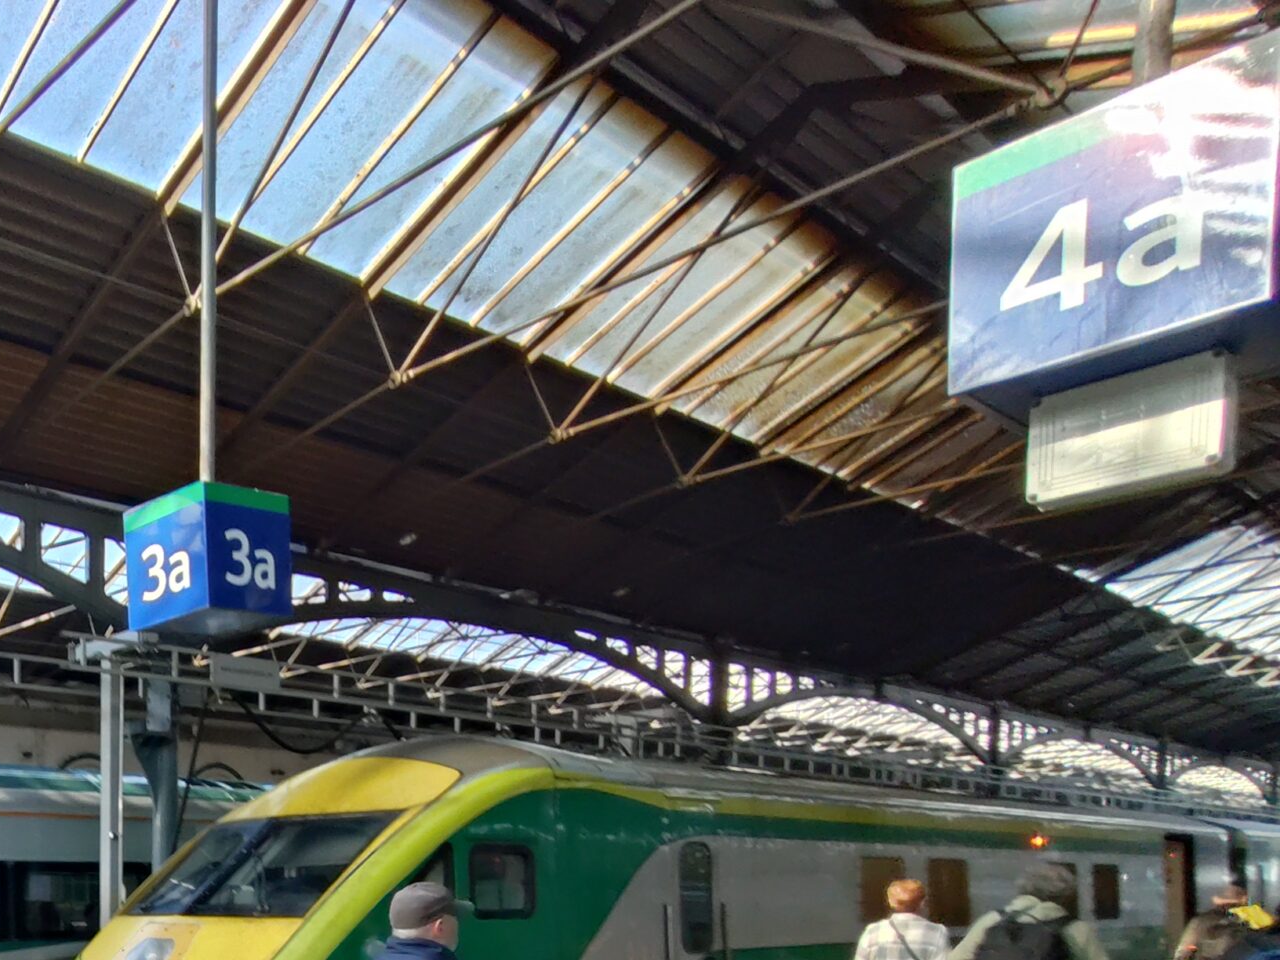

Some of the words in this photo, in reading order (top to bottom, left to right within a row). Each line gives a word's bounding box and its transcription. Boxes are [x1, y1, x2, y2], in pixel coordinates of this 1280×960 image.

[999, 196, 1204, 312] 4a
[141, 543, 191, 602] 3a
[224, 528, 276, 591] 3a
